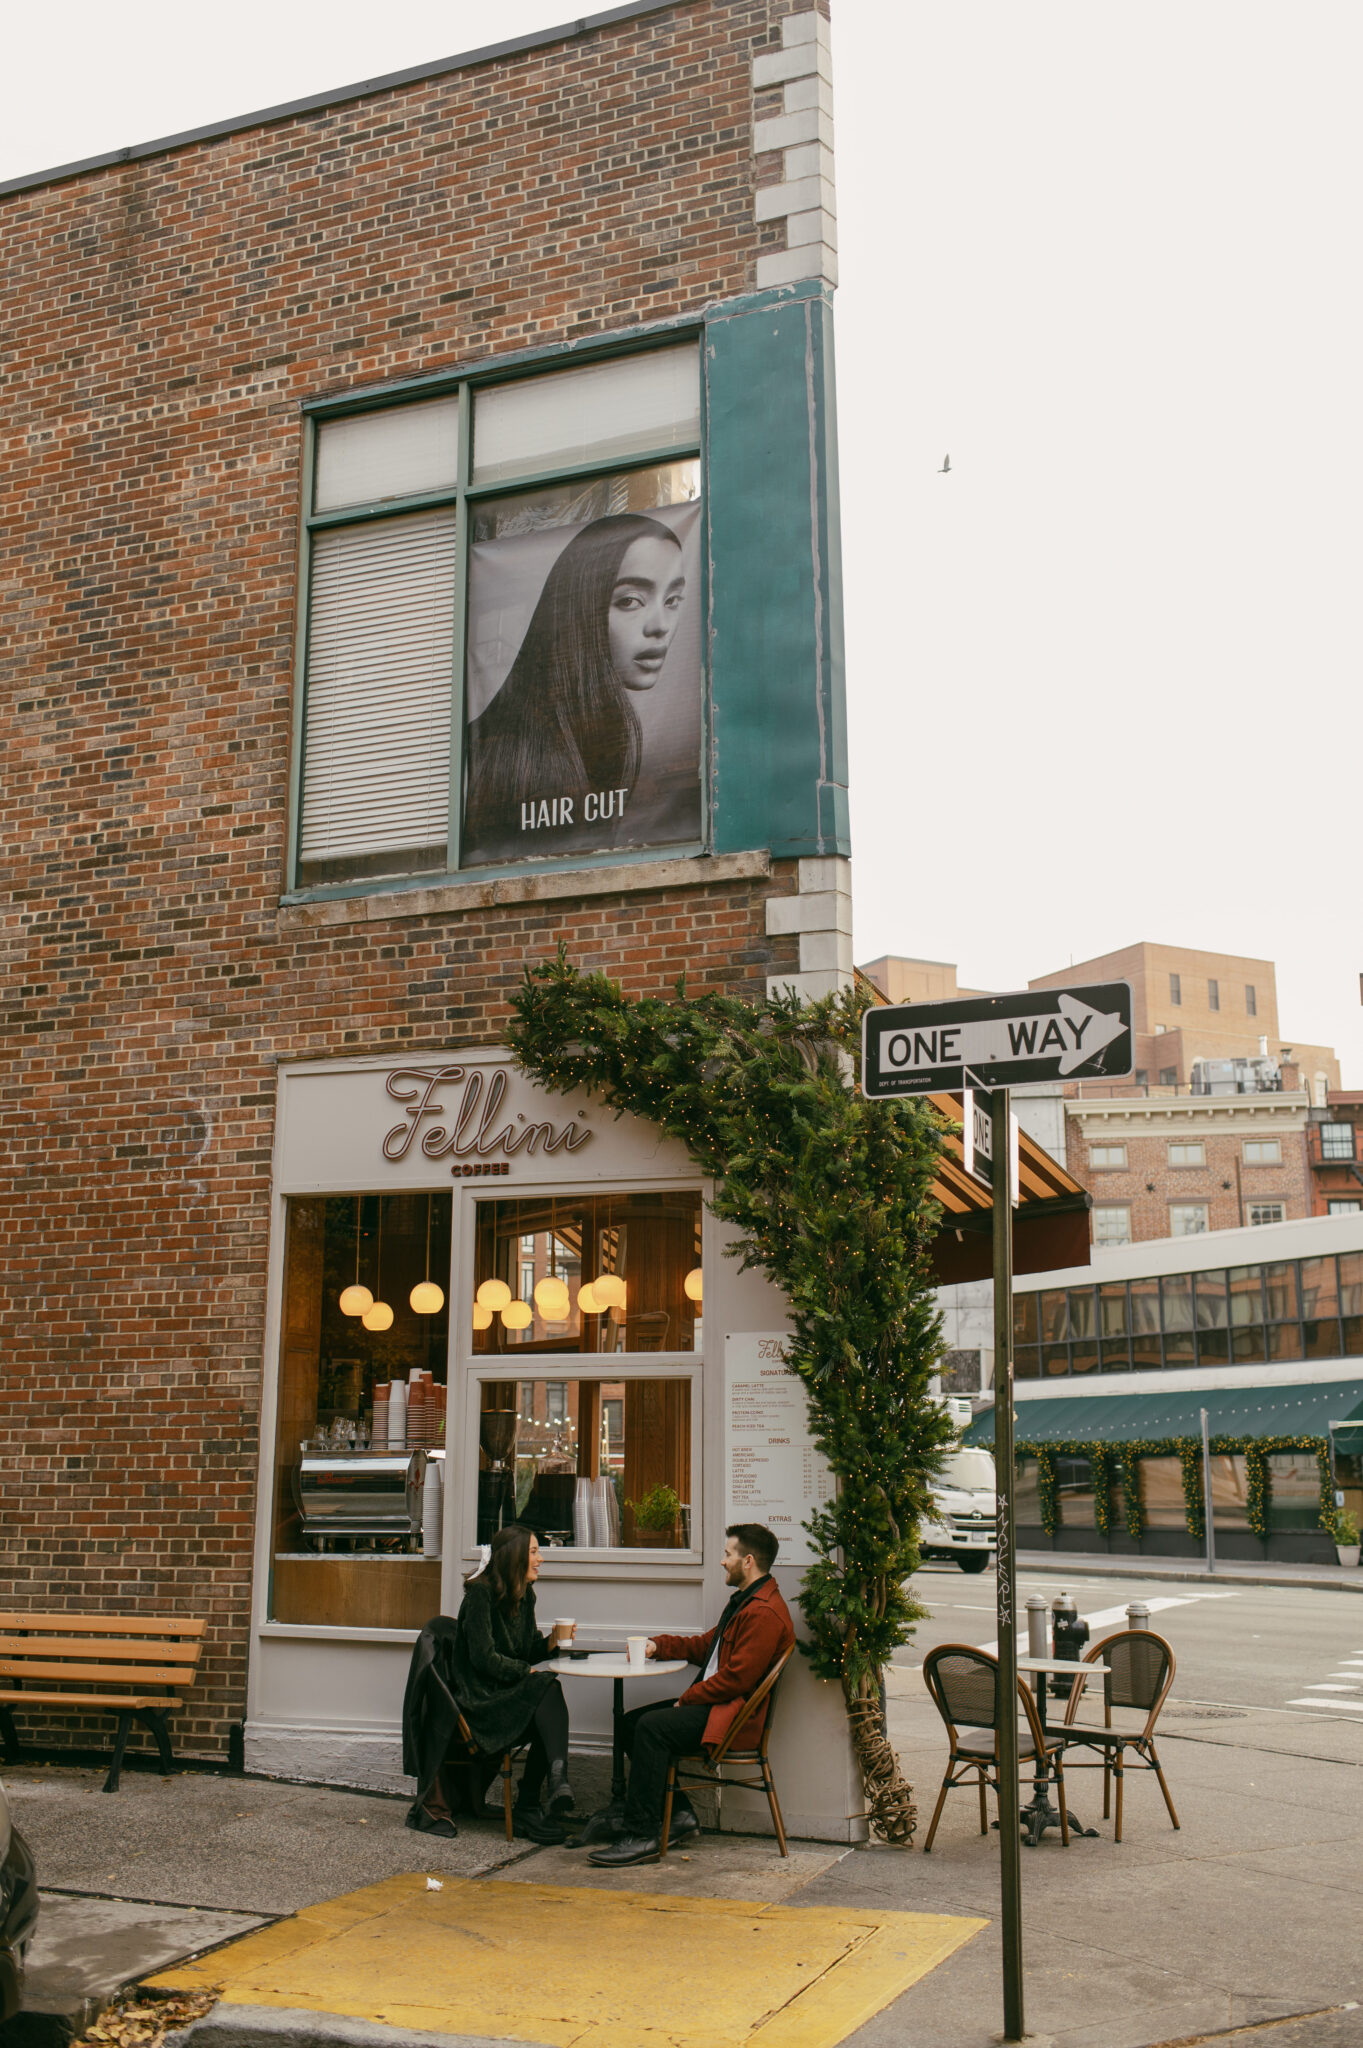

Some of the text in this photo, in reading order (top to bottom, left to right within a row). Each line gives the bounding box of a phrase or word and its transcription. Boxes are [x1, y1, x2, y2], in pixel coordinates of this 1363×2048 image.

[521, 788, 629, 831] HAIR CUT
[888, 1014, 1093, 1067] ONE WAY
[898, 1077, 931, 1086] TRANSPORTATION
[382, 1065, 593, 1162] Fellini
[974, 1109, 989, 1155] ONE
[450, 1162, 510, 1178] COFFEE
[758, 1339, 793, 1359] Fell
